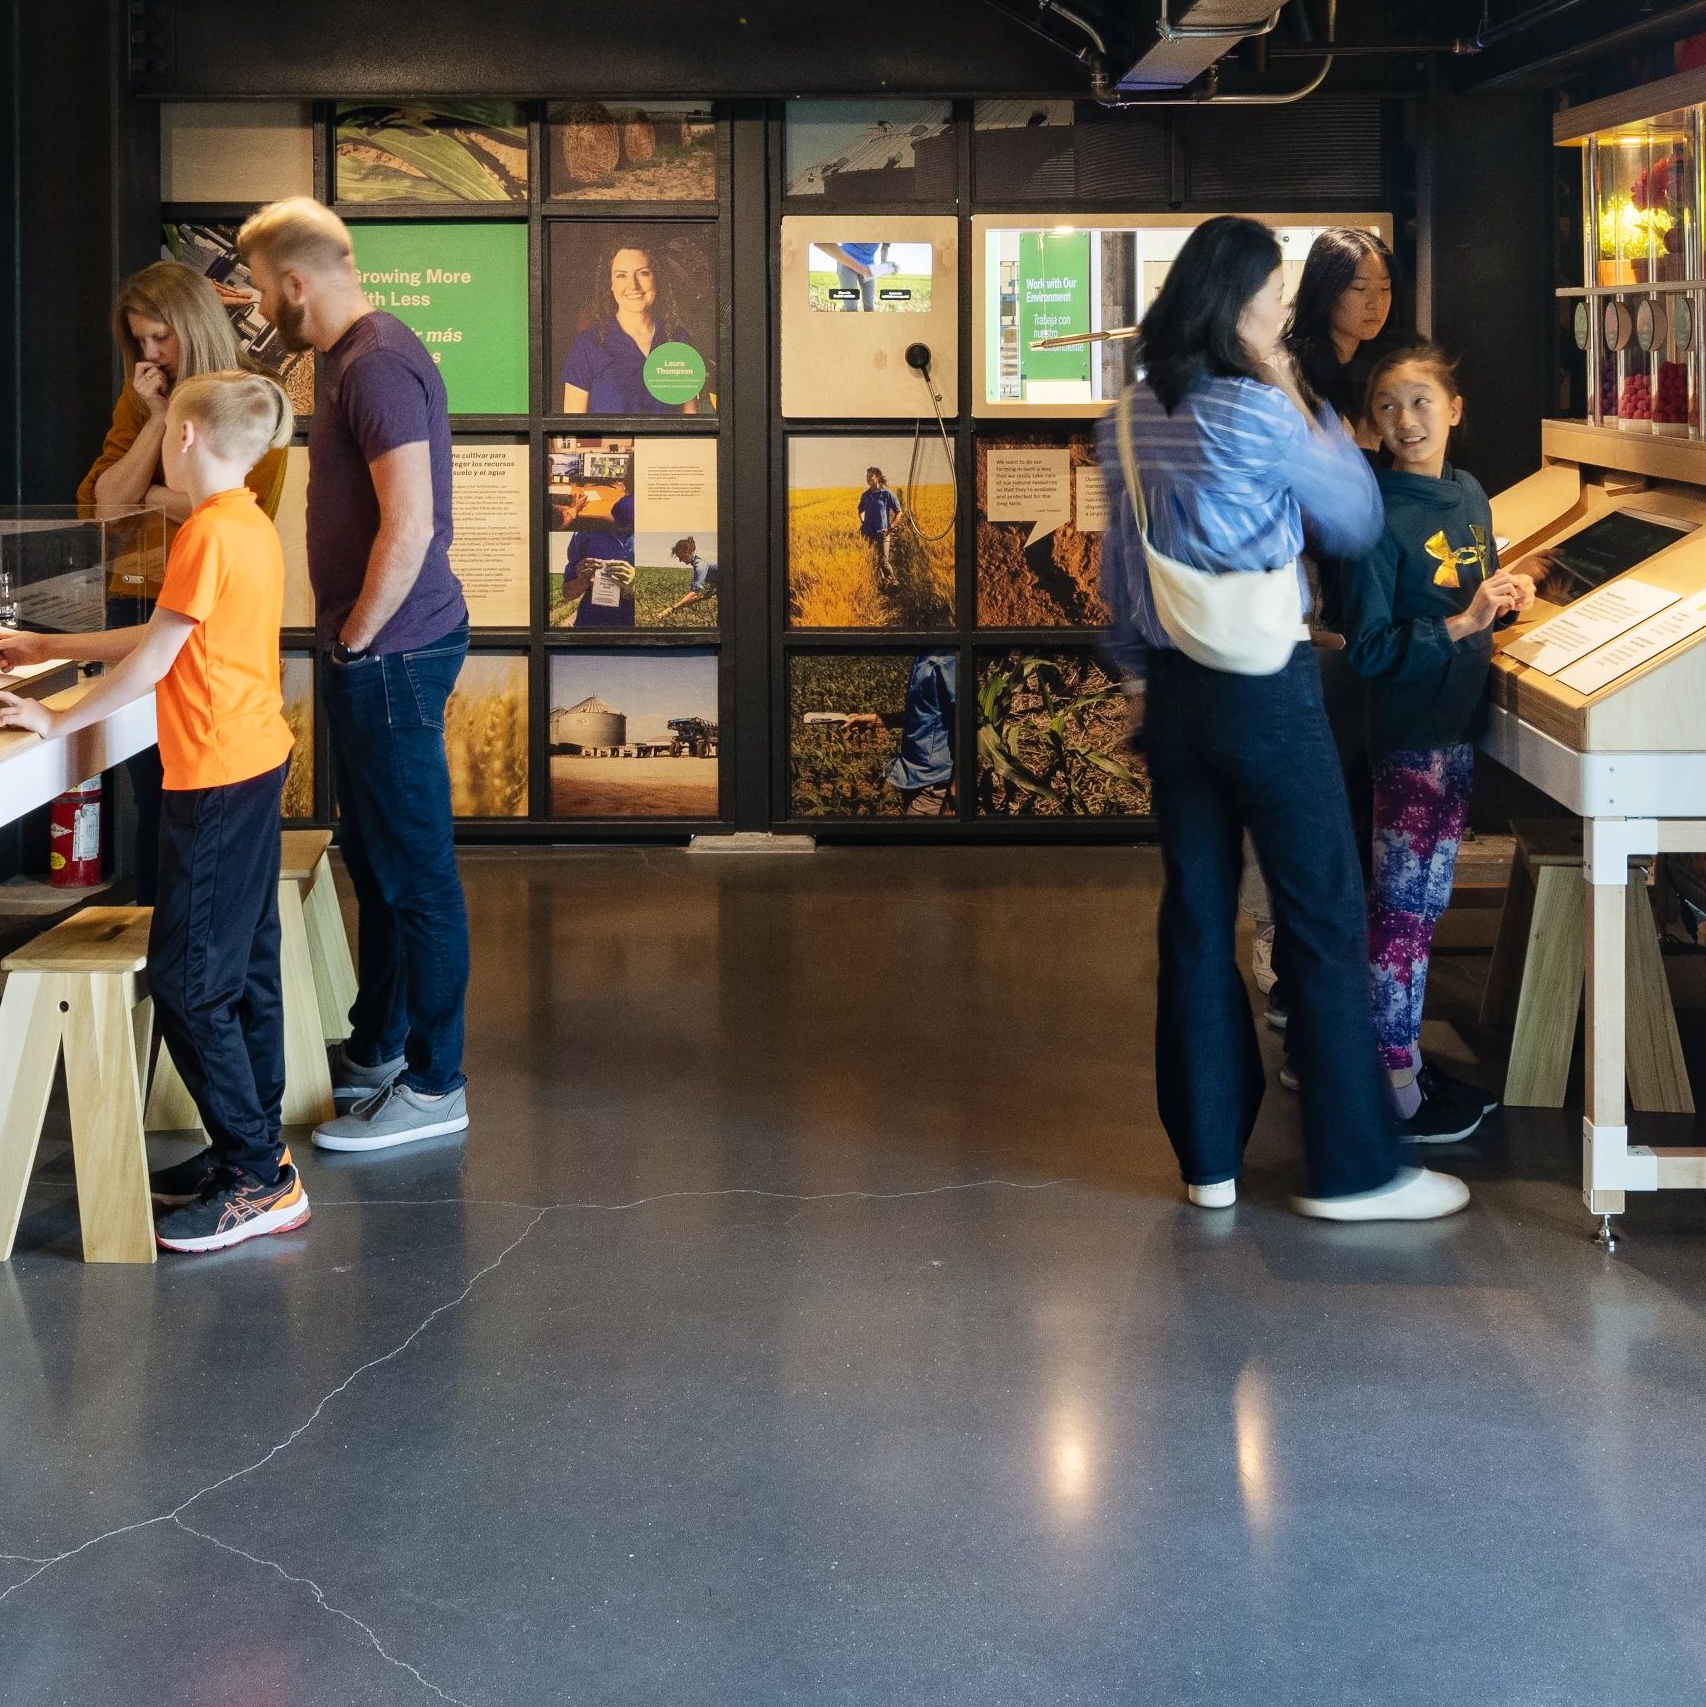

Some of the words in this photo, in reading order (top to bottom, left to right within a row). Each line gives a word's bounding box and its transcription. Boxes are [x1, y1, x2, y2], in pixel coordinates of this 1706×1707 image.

[426, 269, 471, 284] More
[1026, 278, 1045, 289] Work
[1046, 278, 1062, 289] with
[1063, 277, 1077, 288] Our
[391, 292, 430, 306] Less
[1026, 292, 1071, 303] Environment
[1033, 314, 1057, 326] Trabaja
[1058, 316, 1071, 325] con
[426, 328, 463, 343] más
